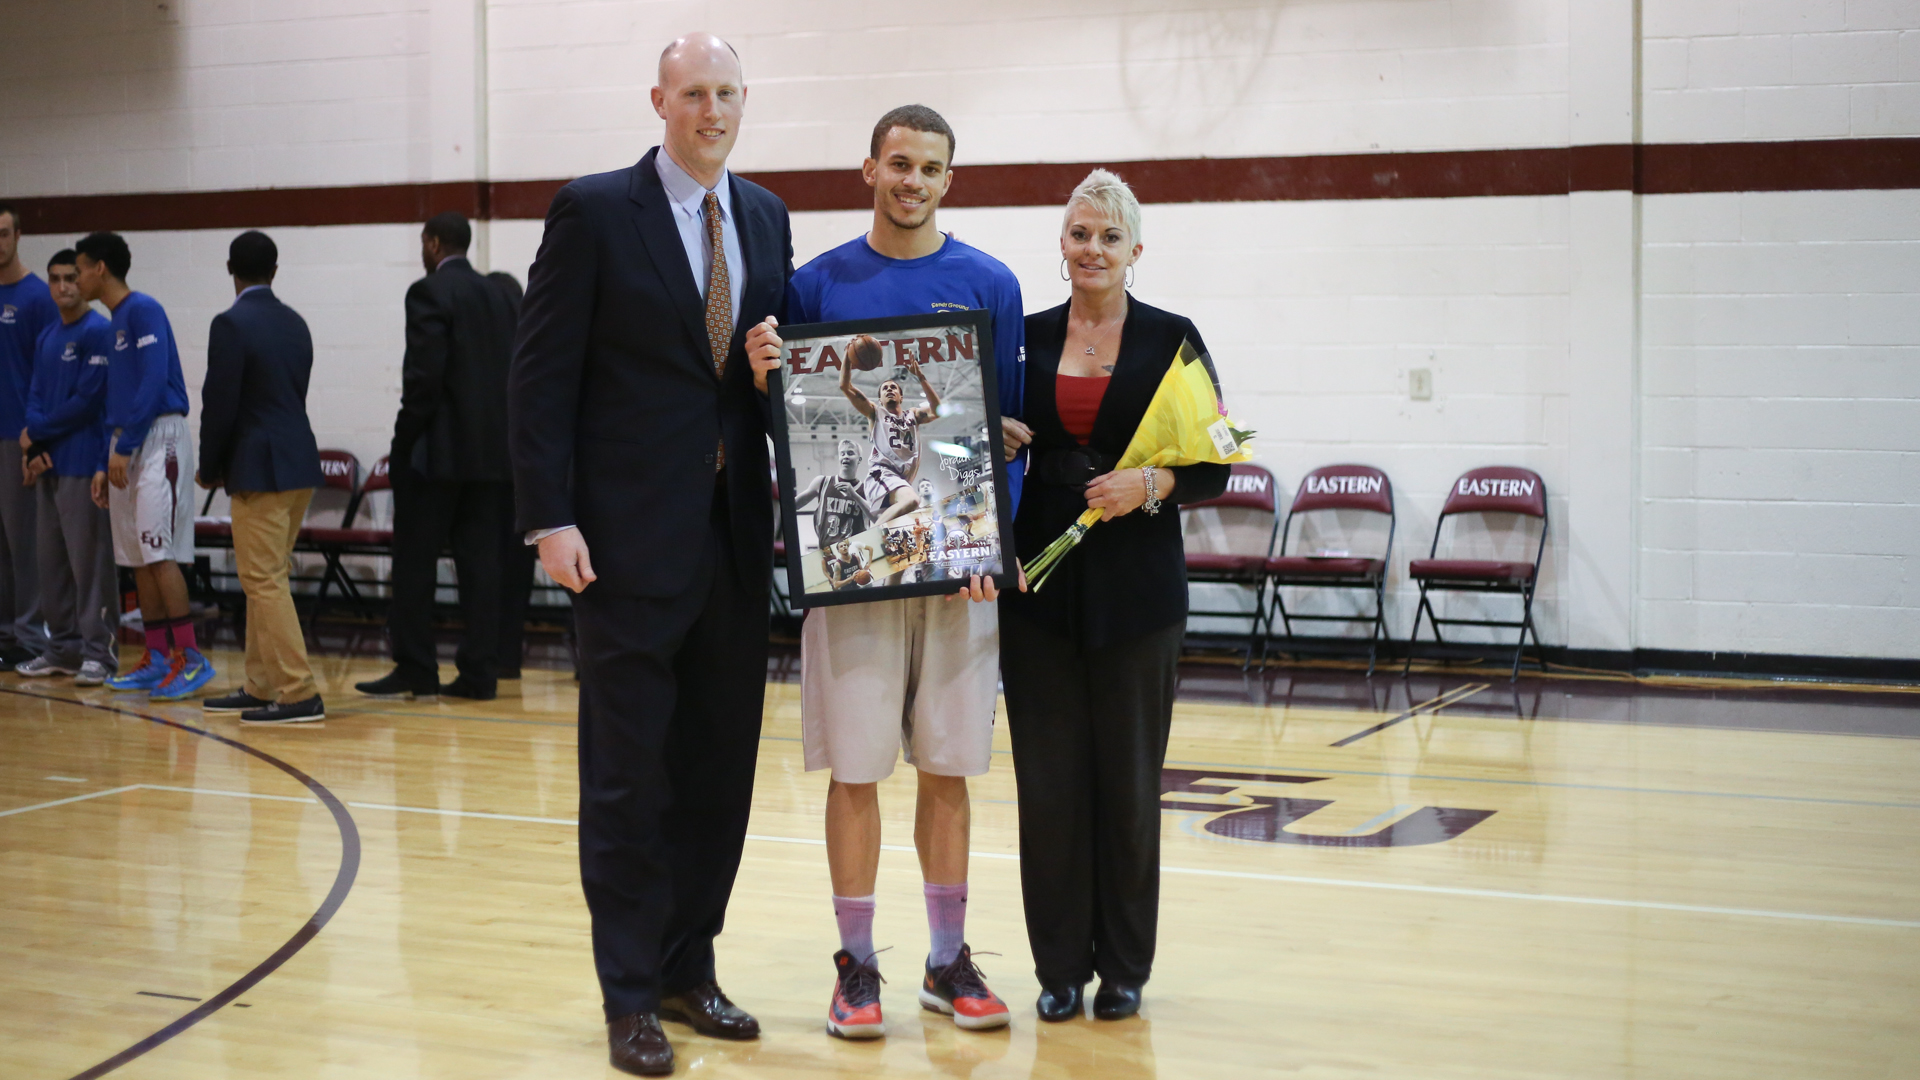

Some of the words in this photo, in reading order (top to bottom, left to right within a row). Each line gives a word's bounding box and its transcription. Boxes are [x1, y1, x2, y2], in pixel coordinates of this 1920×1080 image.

[948, 302, 970, 311] Ground
[787, 334, 975, 375] EAERN
[889, 428, 914, 451] 24
[320, 460, 351, 476] TERN
[938, 451, 971, 471] Jordan
[946, 466, 981, 487] Diggs
[1226, 474, 1268, 493] TERN
[1307, 475, 1382, 494] EASTERN
[1458, 477, 1535, 497] EASTERN
[141, 530, 162, 549] EU
[928, 546, 990, 562] EASTERN
